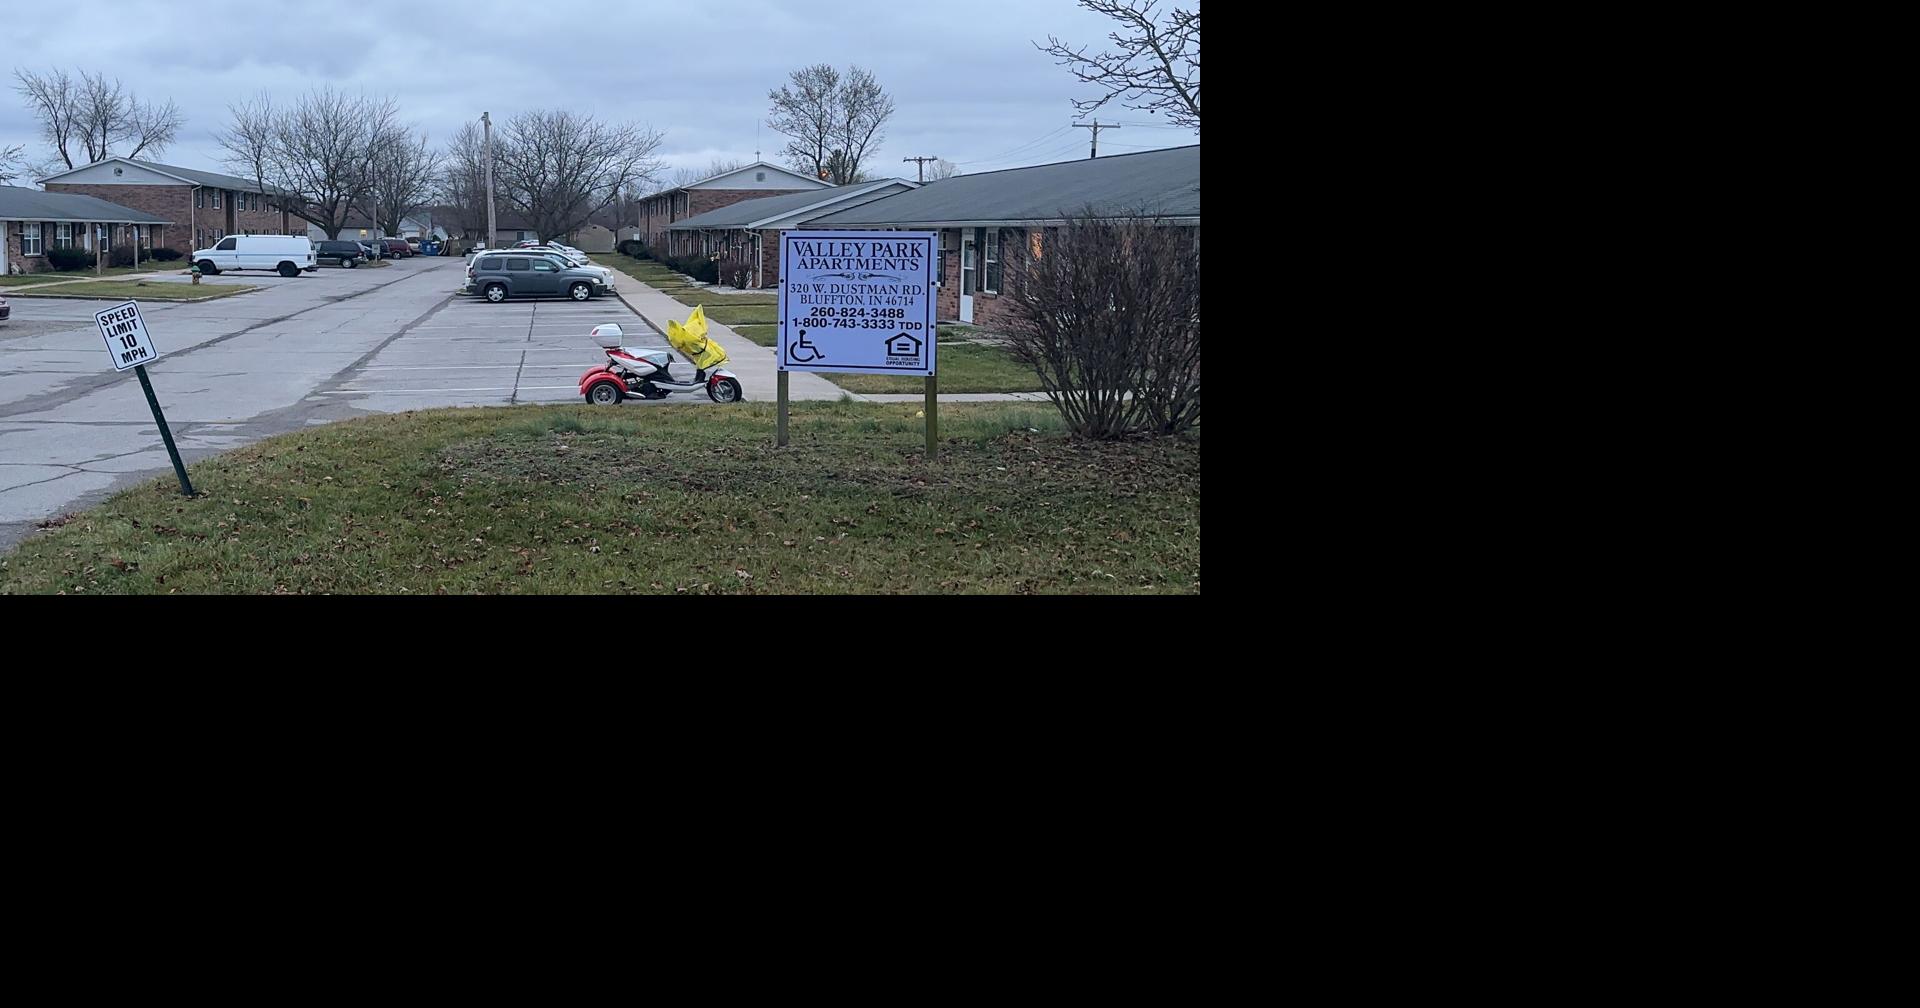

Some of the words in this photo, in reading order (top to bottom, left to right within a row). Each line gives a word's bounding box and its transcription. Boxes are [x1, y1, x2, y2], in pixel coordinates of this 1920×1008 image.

[793, 241, 866, 257] VALLEY
[871, 242, 923, 258] PARK
[797, 258, 919, 271] APARTMENTS
[790, 283, 809, 293] 320
[813, 284, 827, 294] W.
[830, 284, 898, 295] DUSTMAN
[902, 285, 925, 296] RD.
[869, 295, 883, 305] IN
[885, 296, 914, 306] 46714
[100, 307, 136, 326] SPEED
[810, 307, 904, 318] 260-824-3488
[106, 319, 137, 337] LIMIT
[792, 317, 895, 329] 1-800-743-3333
[899, 321, 923, 331] TDD
[120, 334, 137, 349] 10
[121, 347, 147, 363] MPH
